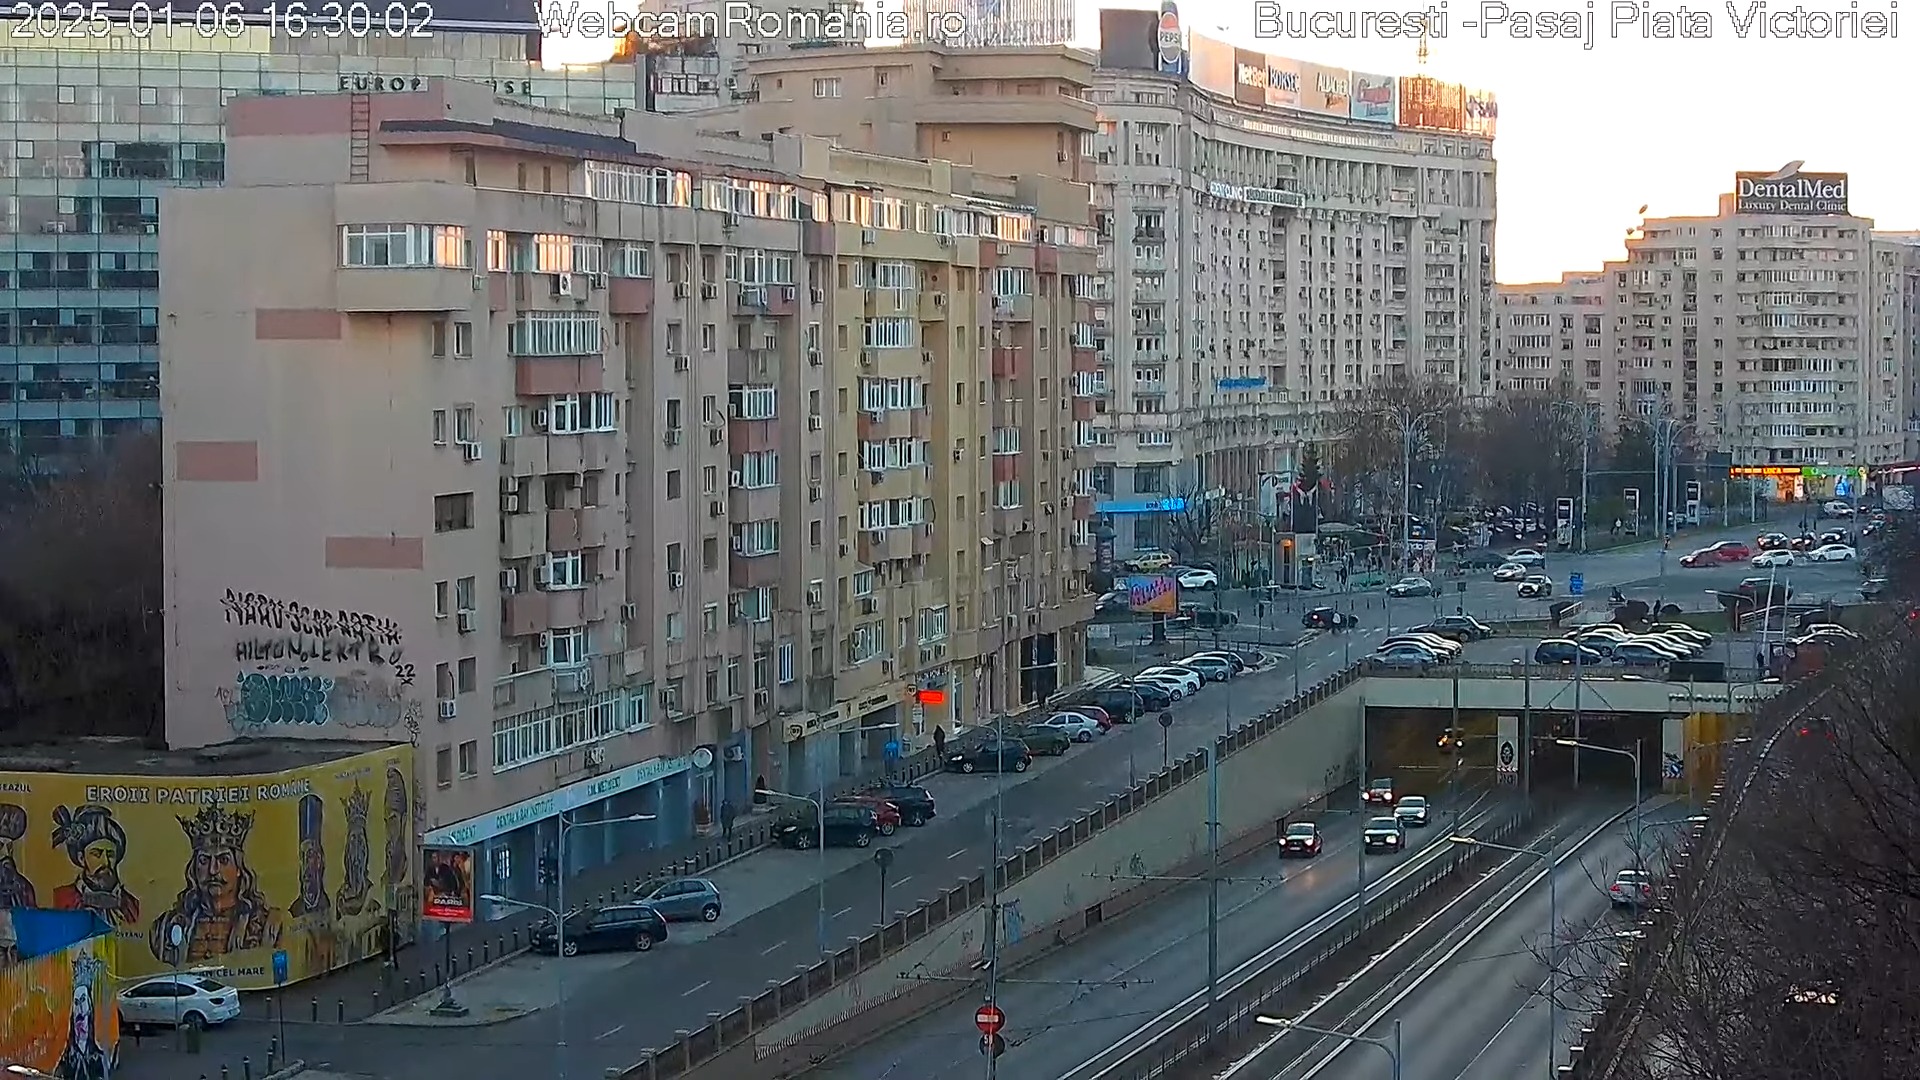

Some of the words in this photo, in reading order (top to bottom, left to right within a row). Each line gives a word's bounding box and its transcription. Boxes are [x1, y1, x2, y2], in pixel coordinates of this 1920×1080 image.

[1739, 178, 1845, 198] DentalMed
[1739, 199, 1776, 212] Luxury
[1780, 200, 1813, 210] Dental
[1816, 201, 1846, 211] Clinic
[86, 785, 150, 803] EROII
[157, 786, 250, 804] PATRIEI
[217, 968, 235, 977] CEL
[238, 966, 265, 977] MARE
